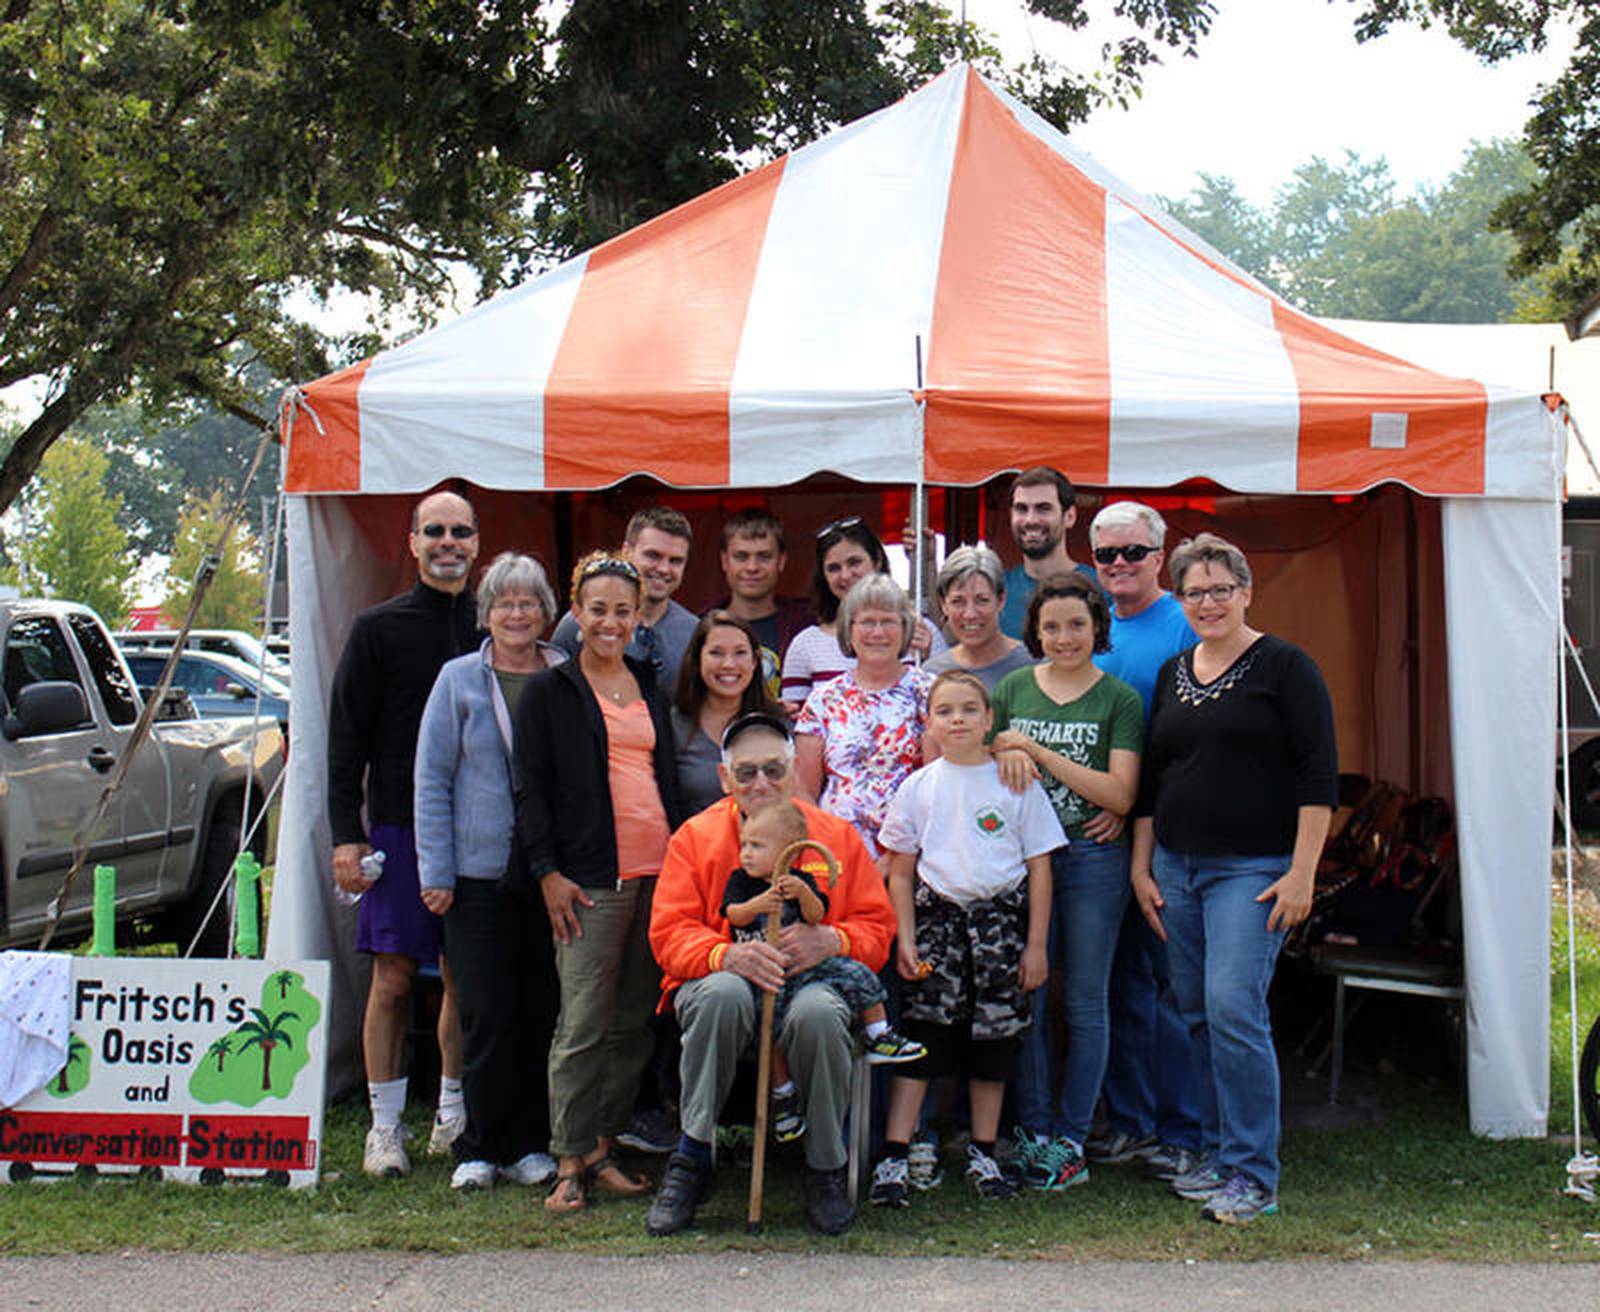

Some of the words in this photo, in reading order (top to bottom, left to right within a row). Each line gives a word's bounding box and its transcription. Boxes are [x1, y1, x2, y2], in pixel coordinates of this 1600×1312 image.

[74, 980, 246, 1022] Fritsch's
[102, 1028, 194, 1065] Oasis
[125, 1075, 170, 1102] and
[0, 1114, 179, 1156] Conversation
[189, 1119, 302, 1162] Station
